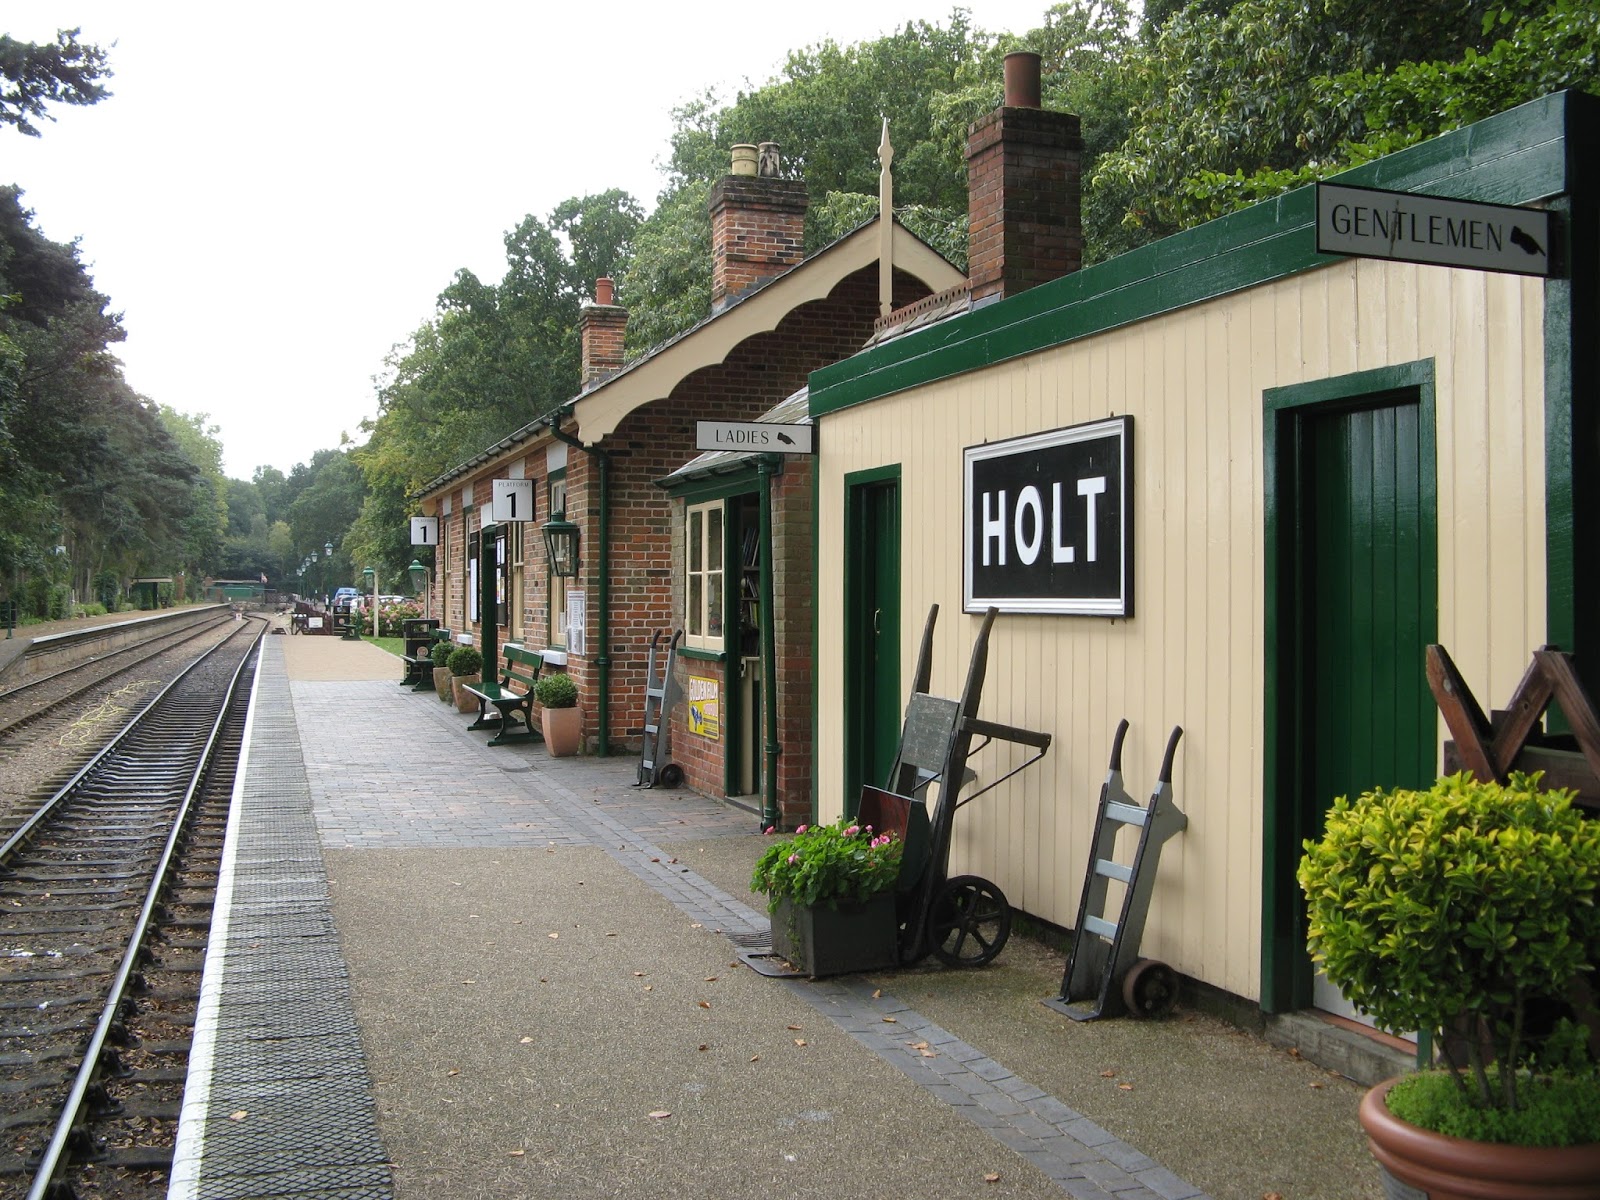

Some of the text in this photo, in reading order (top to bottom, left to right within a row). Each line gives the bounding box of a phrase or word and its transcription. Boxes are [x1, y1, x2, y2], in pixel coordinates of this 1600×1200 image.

[1331, 204, 1503, 251] GENTLEMEN
[715, 429, 769, 444] LADIES
[506, 492, 516, 518] 1
[420, 526, 427, 543] 1
[982, 476, 1107, 567] HOLT
